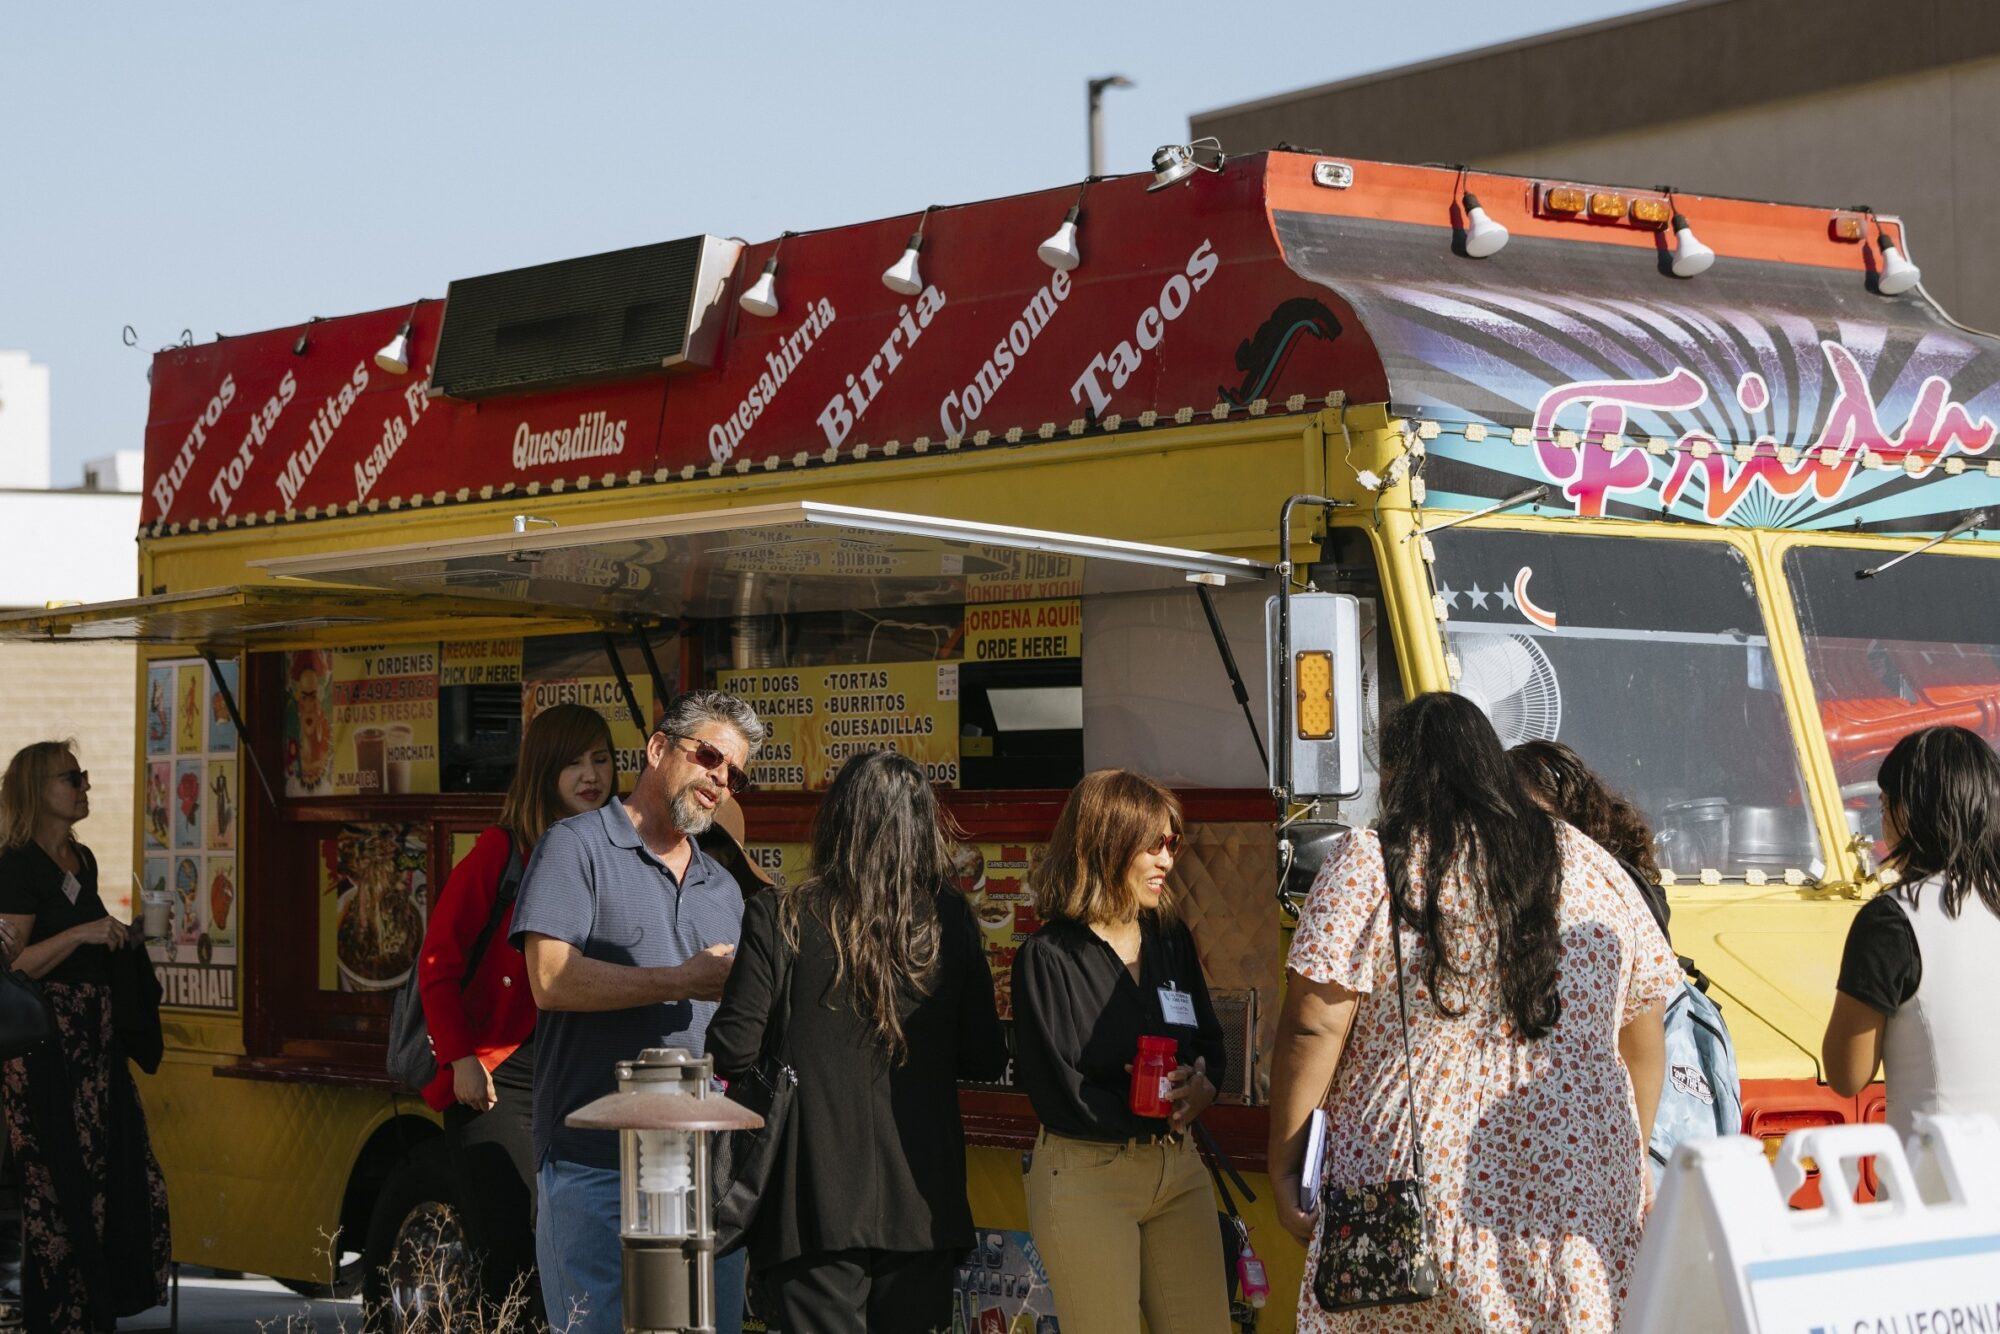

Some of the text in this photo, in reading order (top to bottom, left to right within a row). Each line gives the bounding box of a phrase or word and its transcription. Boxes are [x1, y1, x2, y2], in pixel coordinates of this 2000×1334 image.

[1071, 239, 1219, 418] Tacos
[816, 283, 946, 450] Birria
[940, 268, 1073, 440] Consome
[708, 297, 836, 465] Quesabirria
[152, 373, 236, 524] Burros
[209, 371, 297, 516] Tortas
[276, 361, 369, 513] Mulitas
[513, 411, 627, 470] Quesadillas
[353, 416, 408, 503] Asada
[966, 608, 1032, 636] ¡ORDENA
[976, 636, 1067, 659] ORDE HERE!
[364, 654, 433, 676] Y ORDENES
[443, 664, 520, 683] PICK UP HERE!
[335, 679, 433, 704] 714-492-5026
[729, 676, 799, 693] HOT DOGS
[830, 672, 888, 690] TORTAS
[536, 681, 633, 707] QUESITACO
[746, 698, 813, 715] ARACHES
[830, 694, 905, 713] BURRITOS
[336, 702, 433, 724] AGUAS FRESCAS
[830, 716, 933, 736] QUESADILLAS
[387, 745, 435, 761] HORCHATA
[335, 771, 379, 787] JAMAICA
[749, 767, 804, 783] AMBRES
[155, 965, 234, 1008] OTERIA!!
[1854, 1301, 2000, 1334] CALIFORNI
